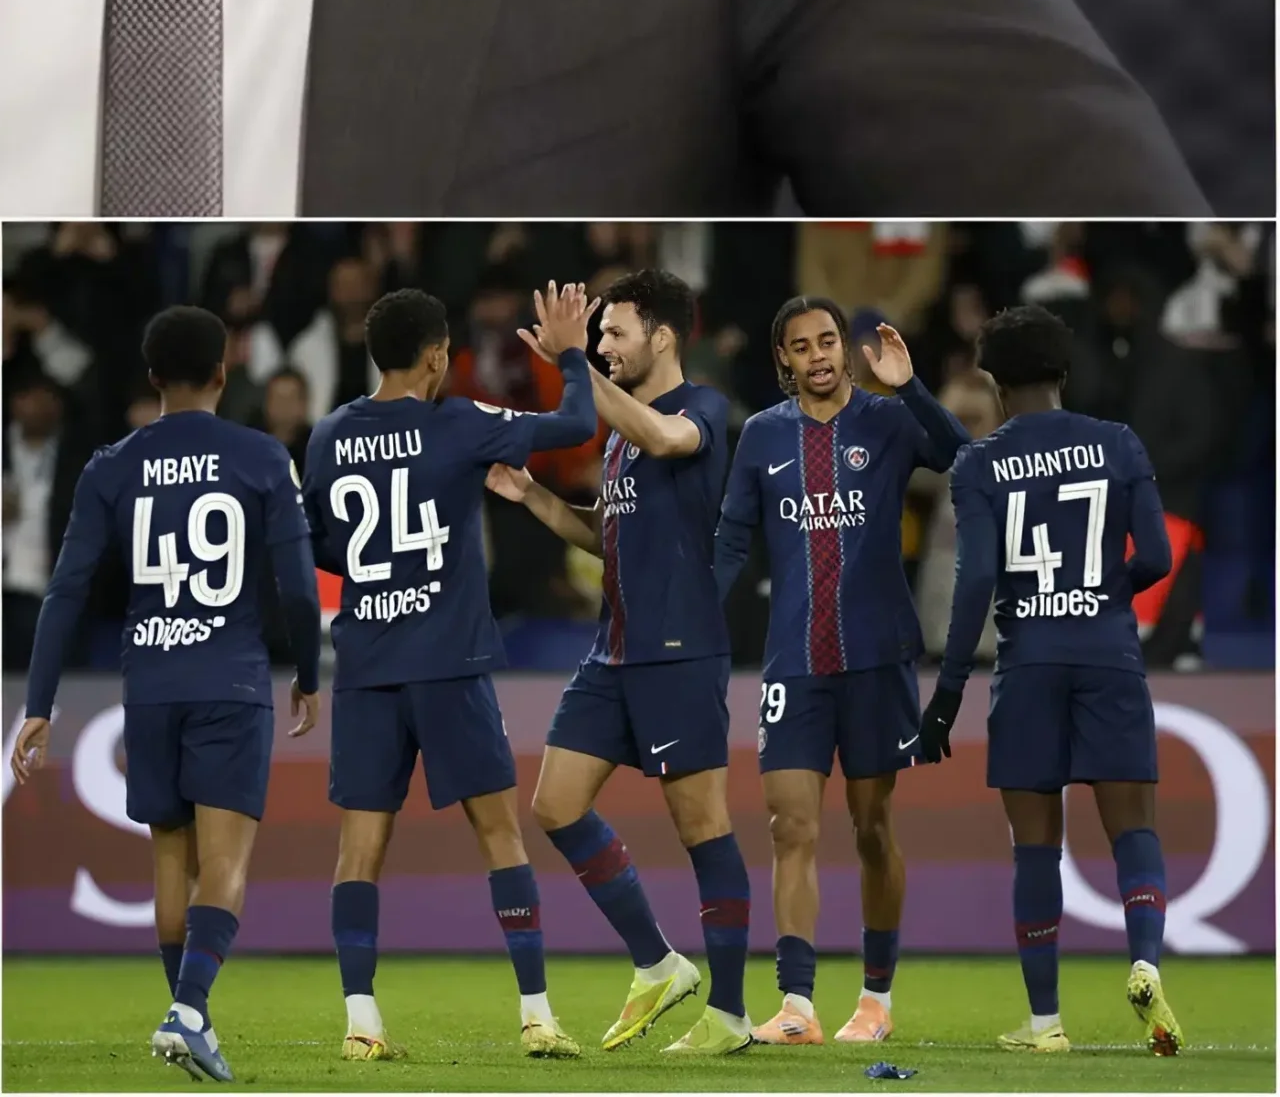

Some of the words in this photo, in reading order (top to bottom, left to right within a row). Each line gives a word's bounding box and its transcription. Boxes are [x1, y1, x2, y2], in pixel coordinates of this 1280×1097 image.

[335, 429, 422, 465] MAYULU
[992, 444, 1105, 482] NDJANTOU
[143, 454, 220, 486] MBAYE
[330, 467, 450, 583] 24
[780, 490, 865, 523] QATAR
[799, 512, 865, 532] AIRWAYS
[132, 492, 246, 608] 49
[1005, 479, 1108, 593] 47
